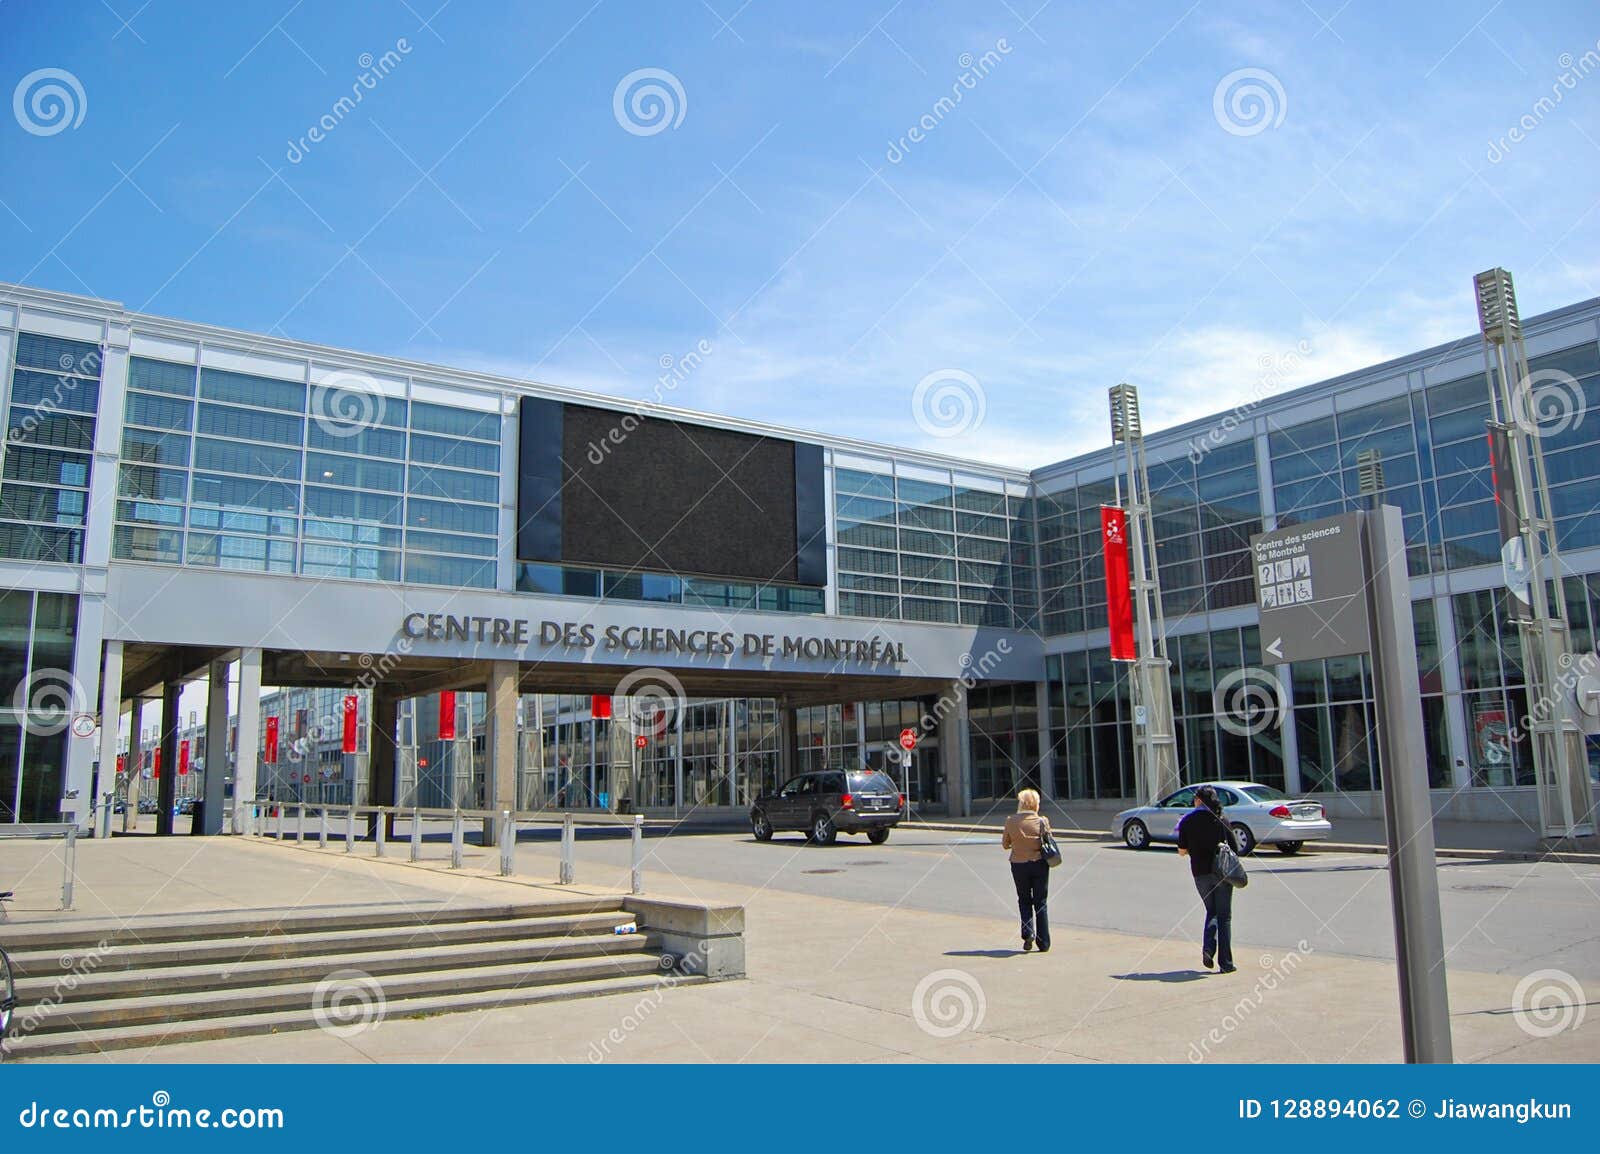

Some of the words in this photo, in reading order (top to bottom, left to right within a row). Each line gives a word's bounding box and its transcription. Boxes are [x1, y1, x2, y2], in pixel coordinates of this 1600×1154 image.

[1255, 539, 1283, 552] Centre
[1285, 535, 1300, 545] des
[1302, 525, 1341, 540] sciences
[1256, 552, 1268, 562] de
[1269, 543, 1306, 559] Montréal
[403, 612, 529, 644] CENTRE
[539, 620, 595, 648] DES
[605, 625, 734, 655] SCIENCES
[743, 633, 775, 657] DE
[783, 635, 909, 663] MONTRÉAL
